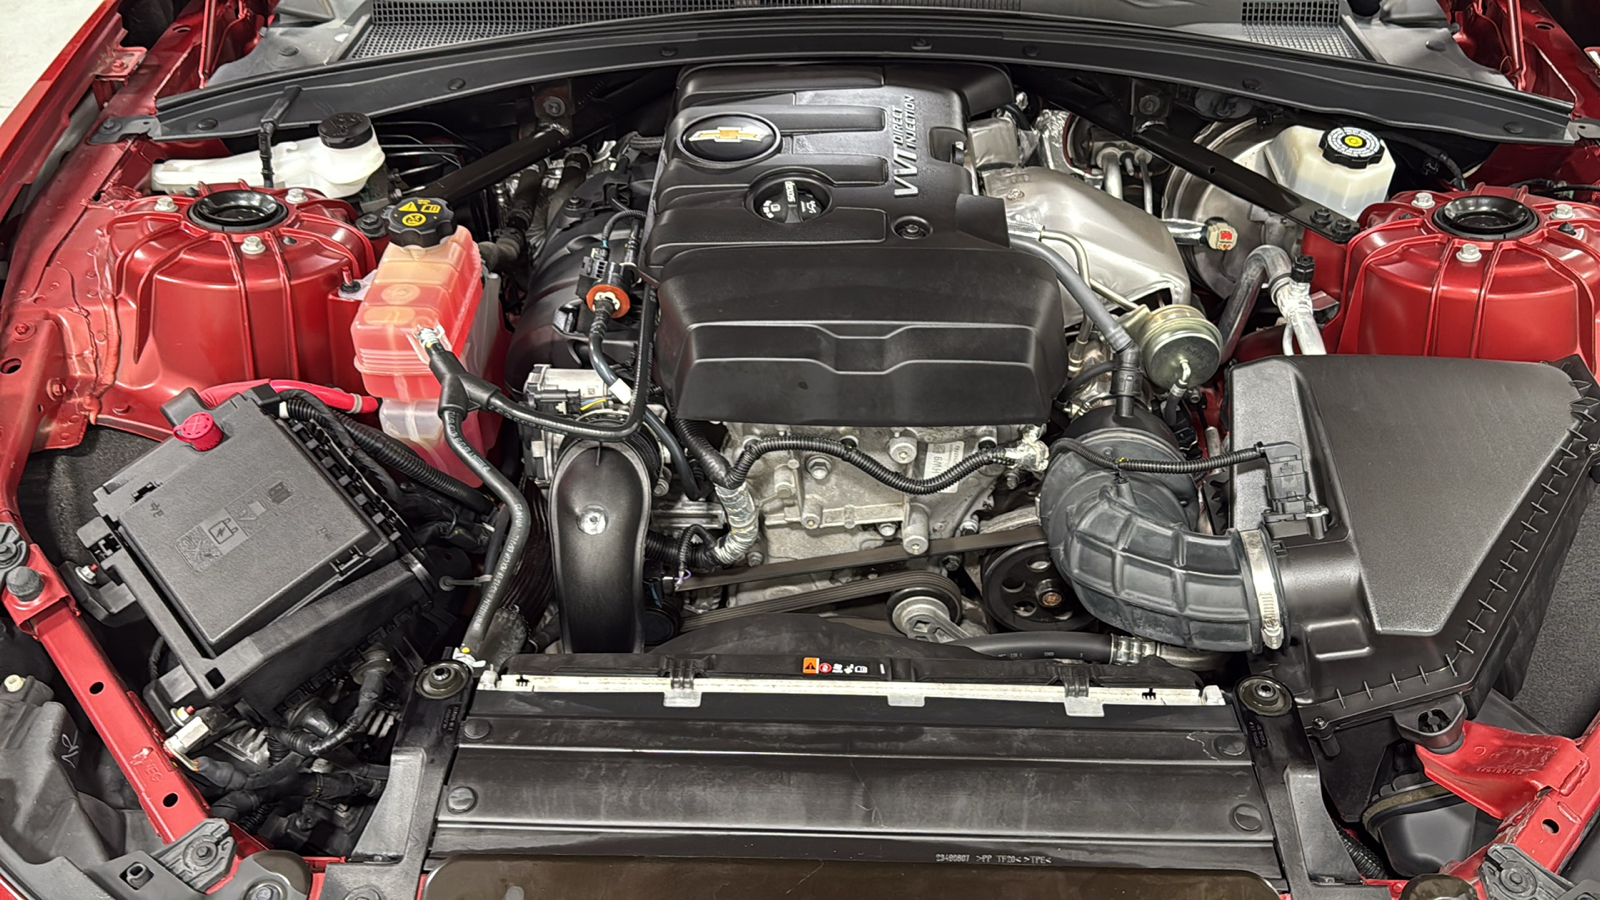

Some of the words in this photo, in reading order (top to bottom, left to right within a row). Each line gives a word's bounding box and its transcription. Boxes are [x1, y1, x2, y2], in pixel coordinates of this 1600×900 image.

[893, 105, 904, 146] DIRECT
[905, 94, 917, 150] INJECTION
[893, 146, 918, 196] VVT
